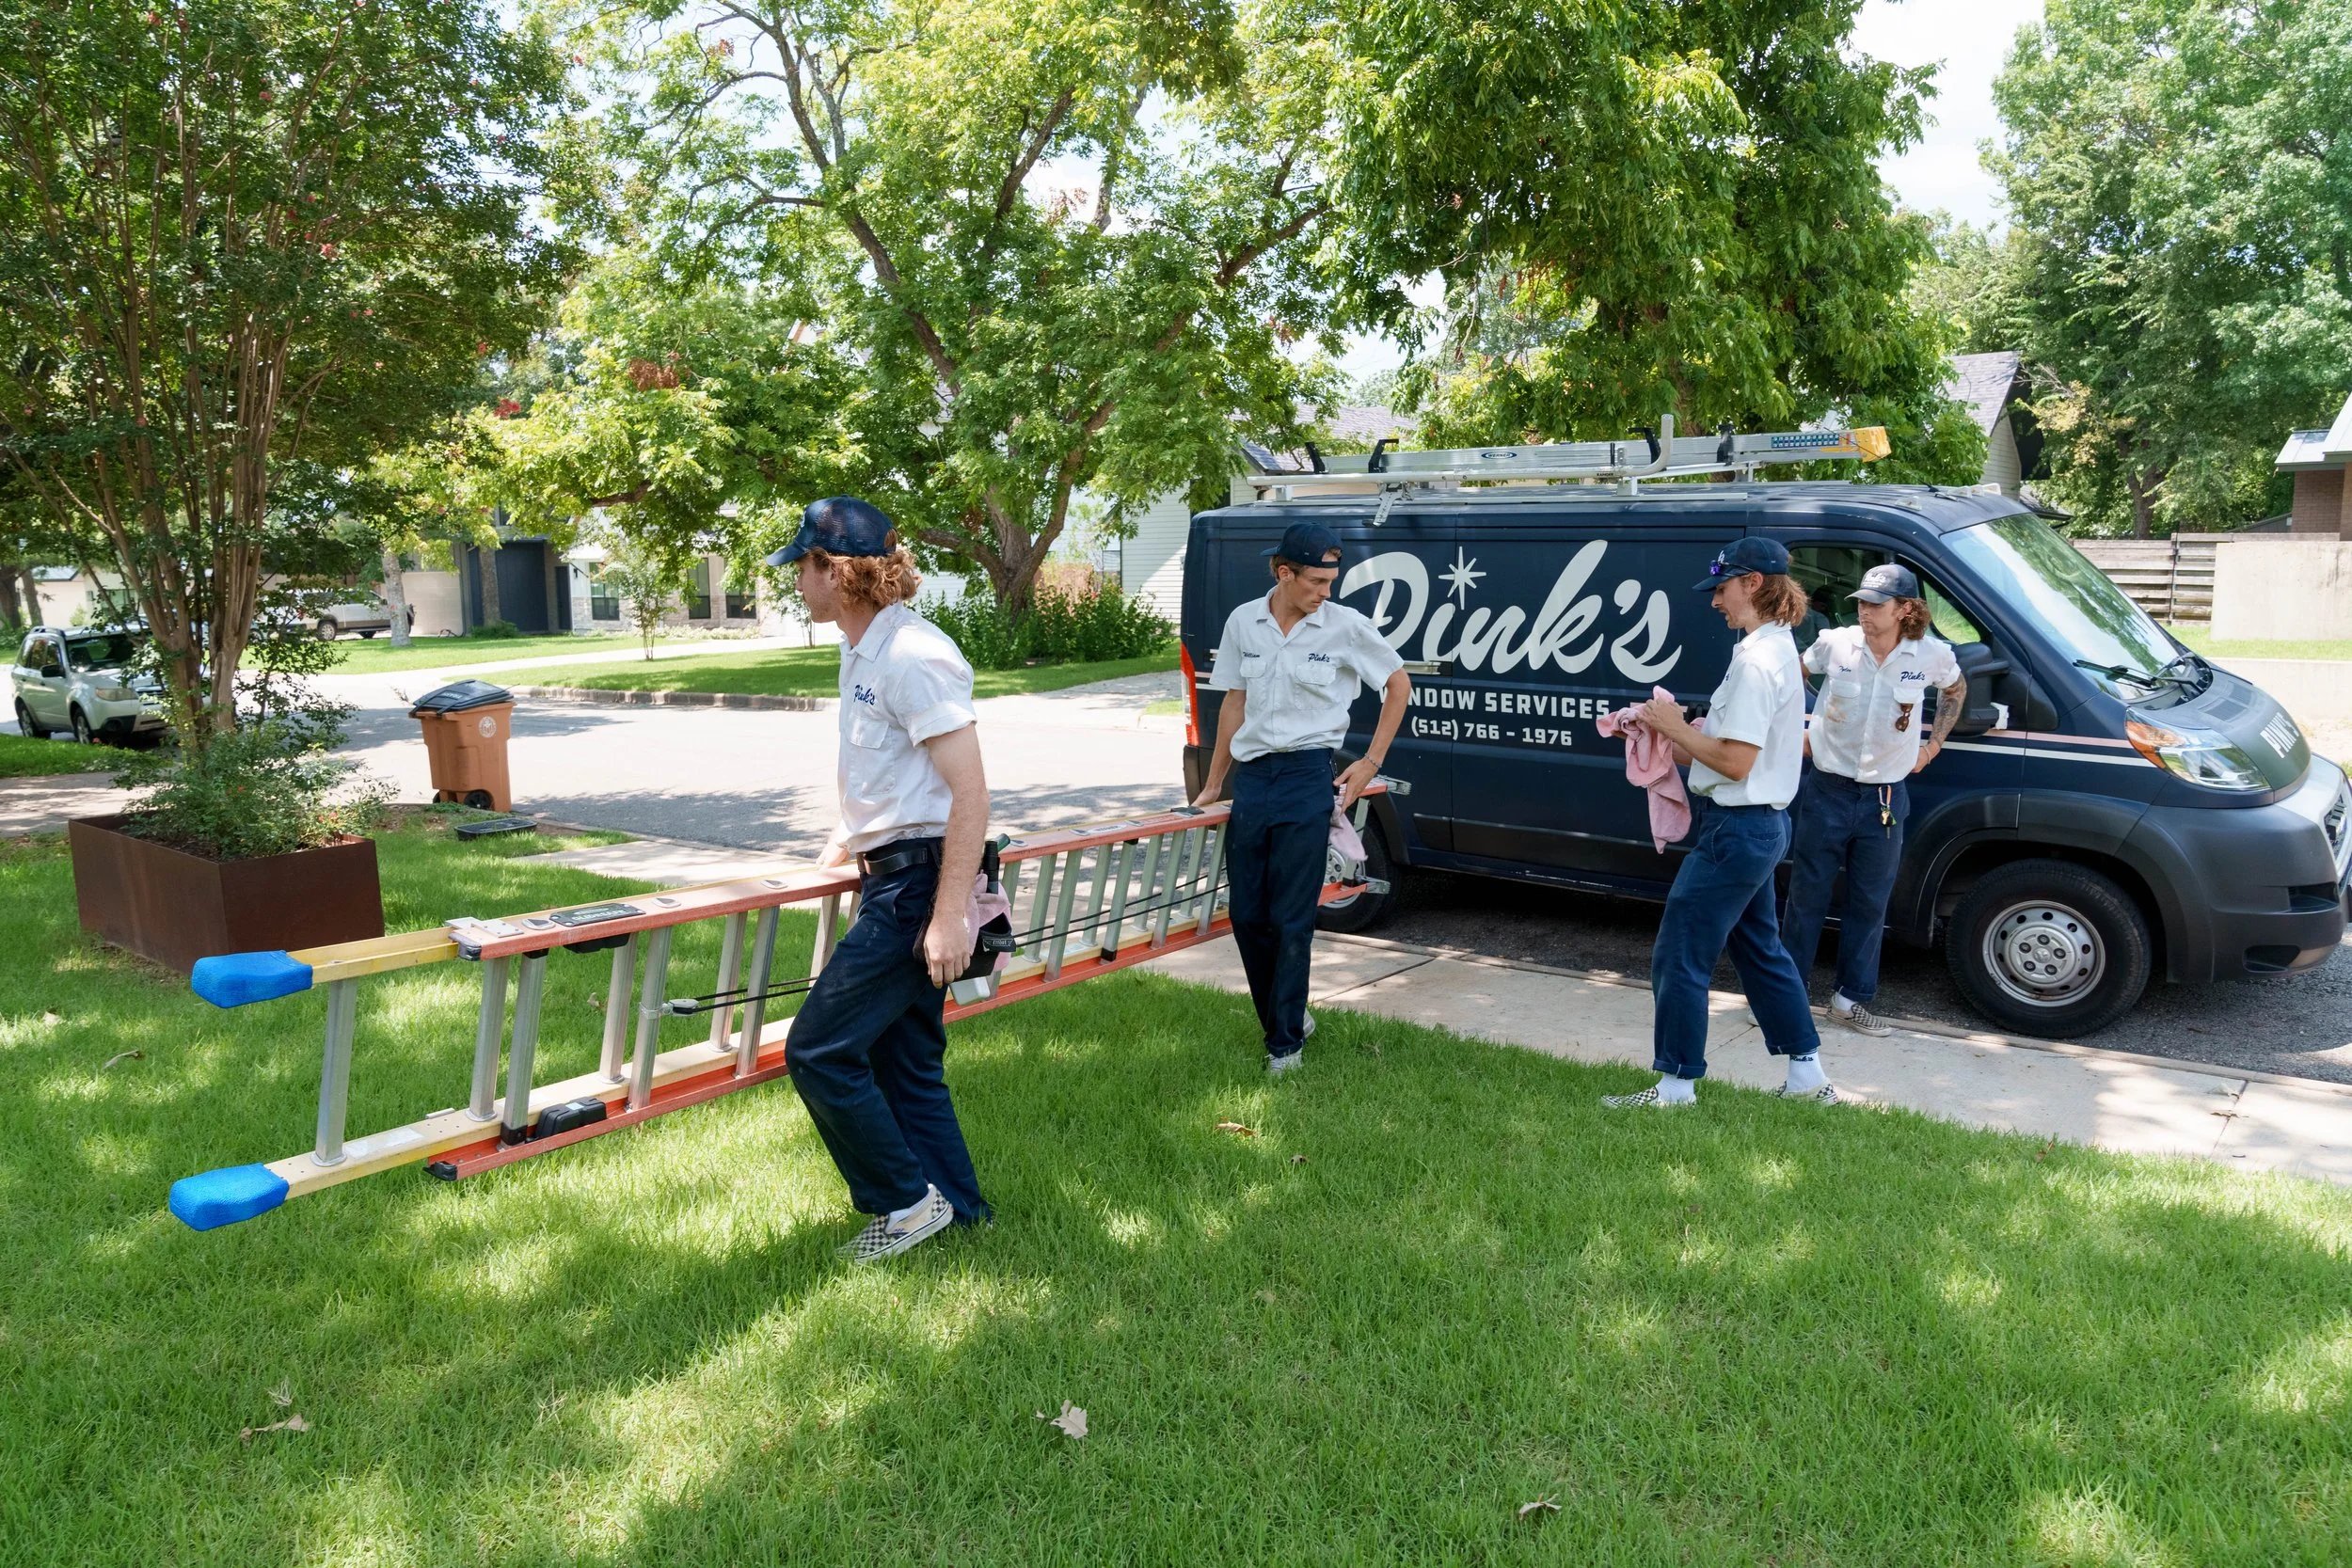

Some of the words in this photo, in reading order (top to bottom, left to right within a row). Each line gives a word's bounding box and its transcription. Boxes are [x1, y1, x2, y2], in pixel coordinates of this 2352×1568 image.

[1340, 539, 1682, 701] Pink's
[1308, 653, 1330, 663] Pink's
[1900, 671, 1926, 682] Pink's
[853, 684, 876, 705] Pink's
[1378, 687, 1476, 711] NDOW
[1485, 692, 1610, 720] SERVICES
[1411, 715, 1459, 741] (512)
[1464, 722, 1500, 740] 766
[1522, 727, 1573, 746] 1976
